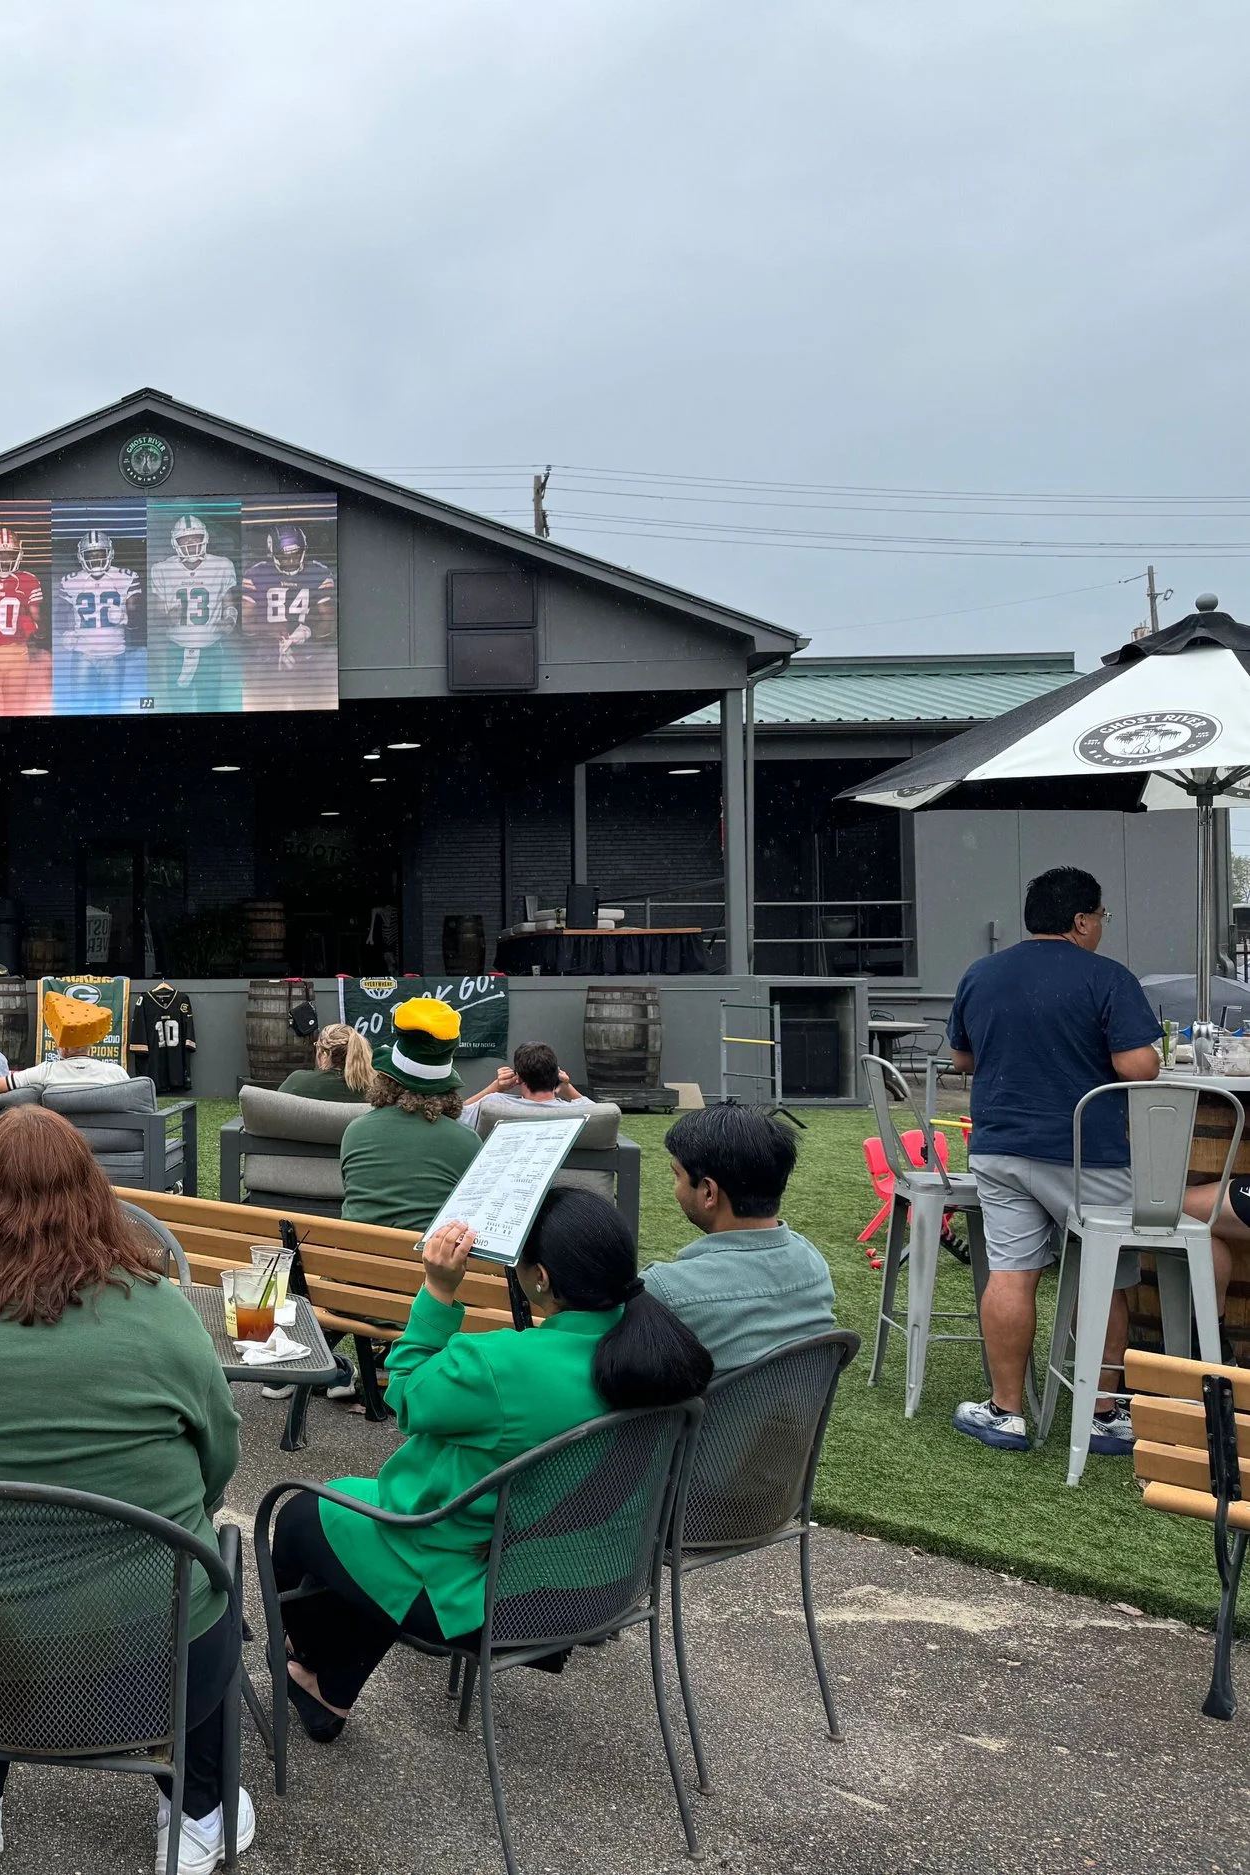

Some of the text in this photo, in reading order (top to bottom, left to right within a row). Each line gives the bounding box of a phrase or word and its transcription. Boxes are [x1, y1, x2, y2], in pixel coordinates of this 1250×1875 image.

[126, 437, 166, 453] GHOST RIVER
[76, 591, 121, 628] 22
[176, 588, 210, 626] 13
[266, 587, 310, 623] 84
[1100, 714, 1208, 735] GHOST RIVER
[1088, 740, 1201, 765] BREWING CO.
[458, 976, 495, 1000] GO!
[155, 1020, 179, 1048] 10
[354, 1012, 384, 1036] GO
[45, 1040, 57, 1053] NF
[103, 1034, 121, 1044] 2010
[87, 1046, 119, 1057] PIONS
